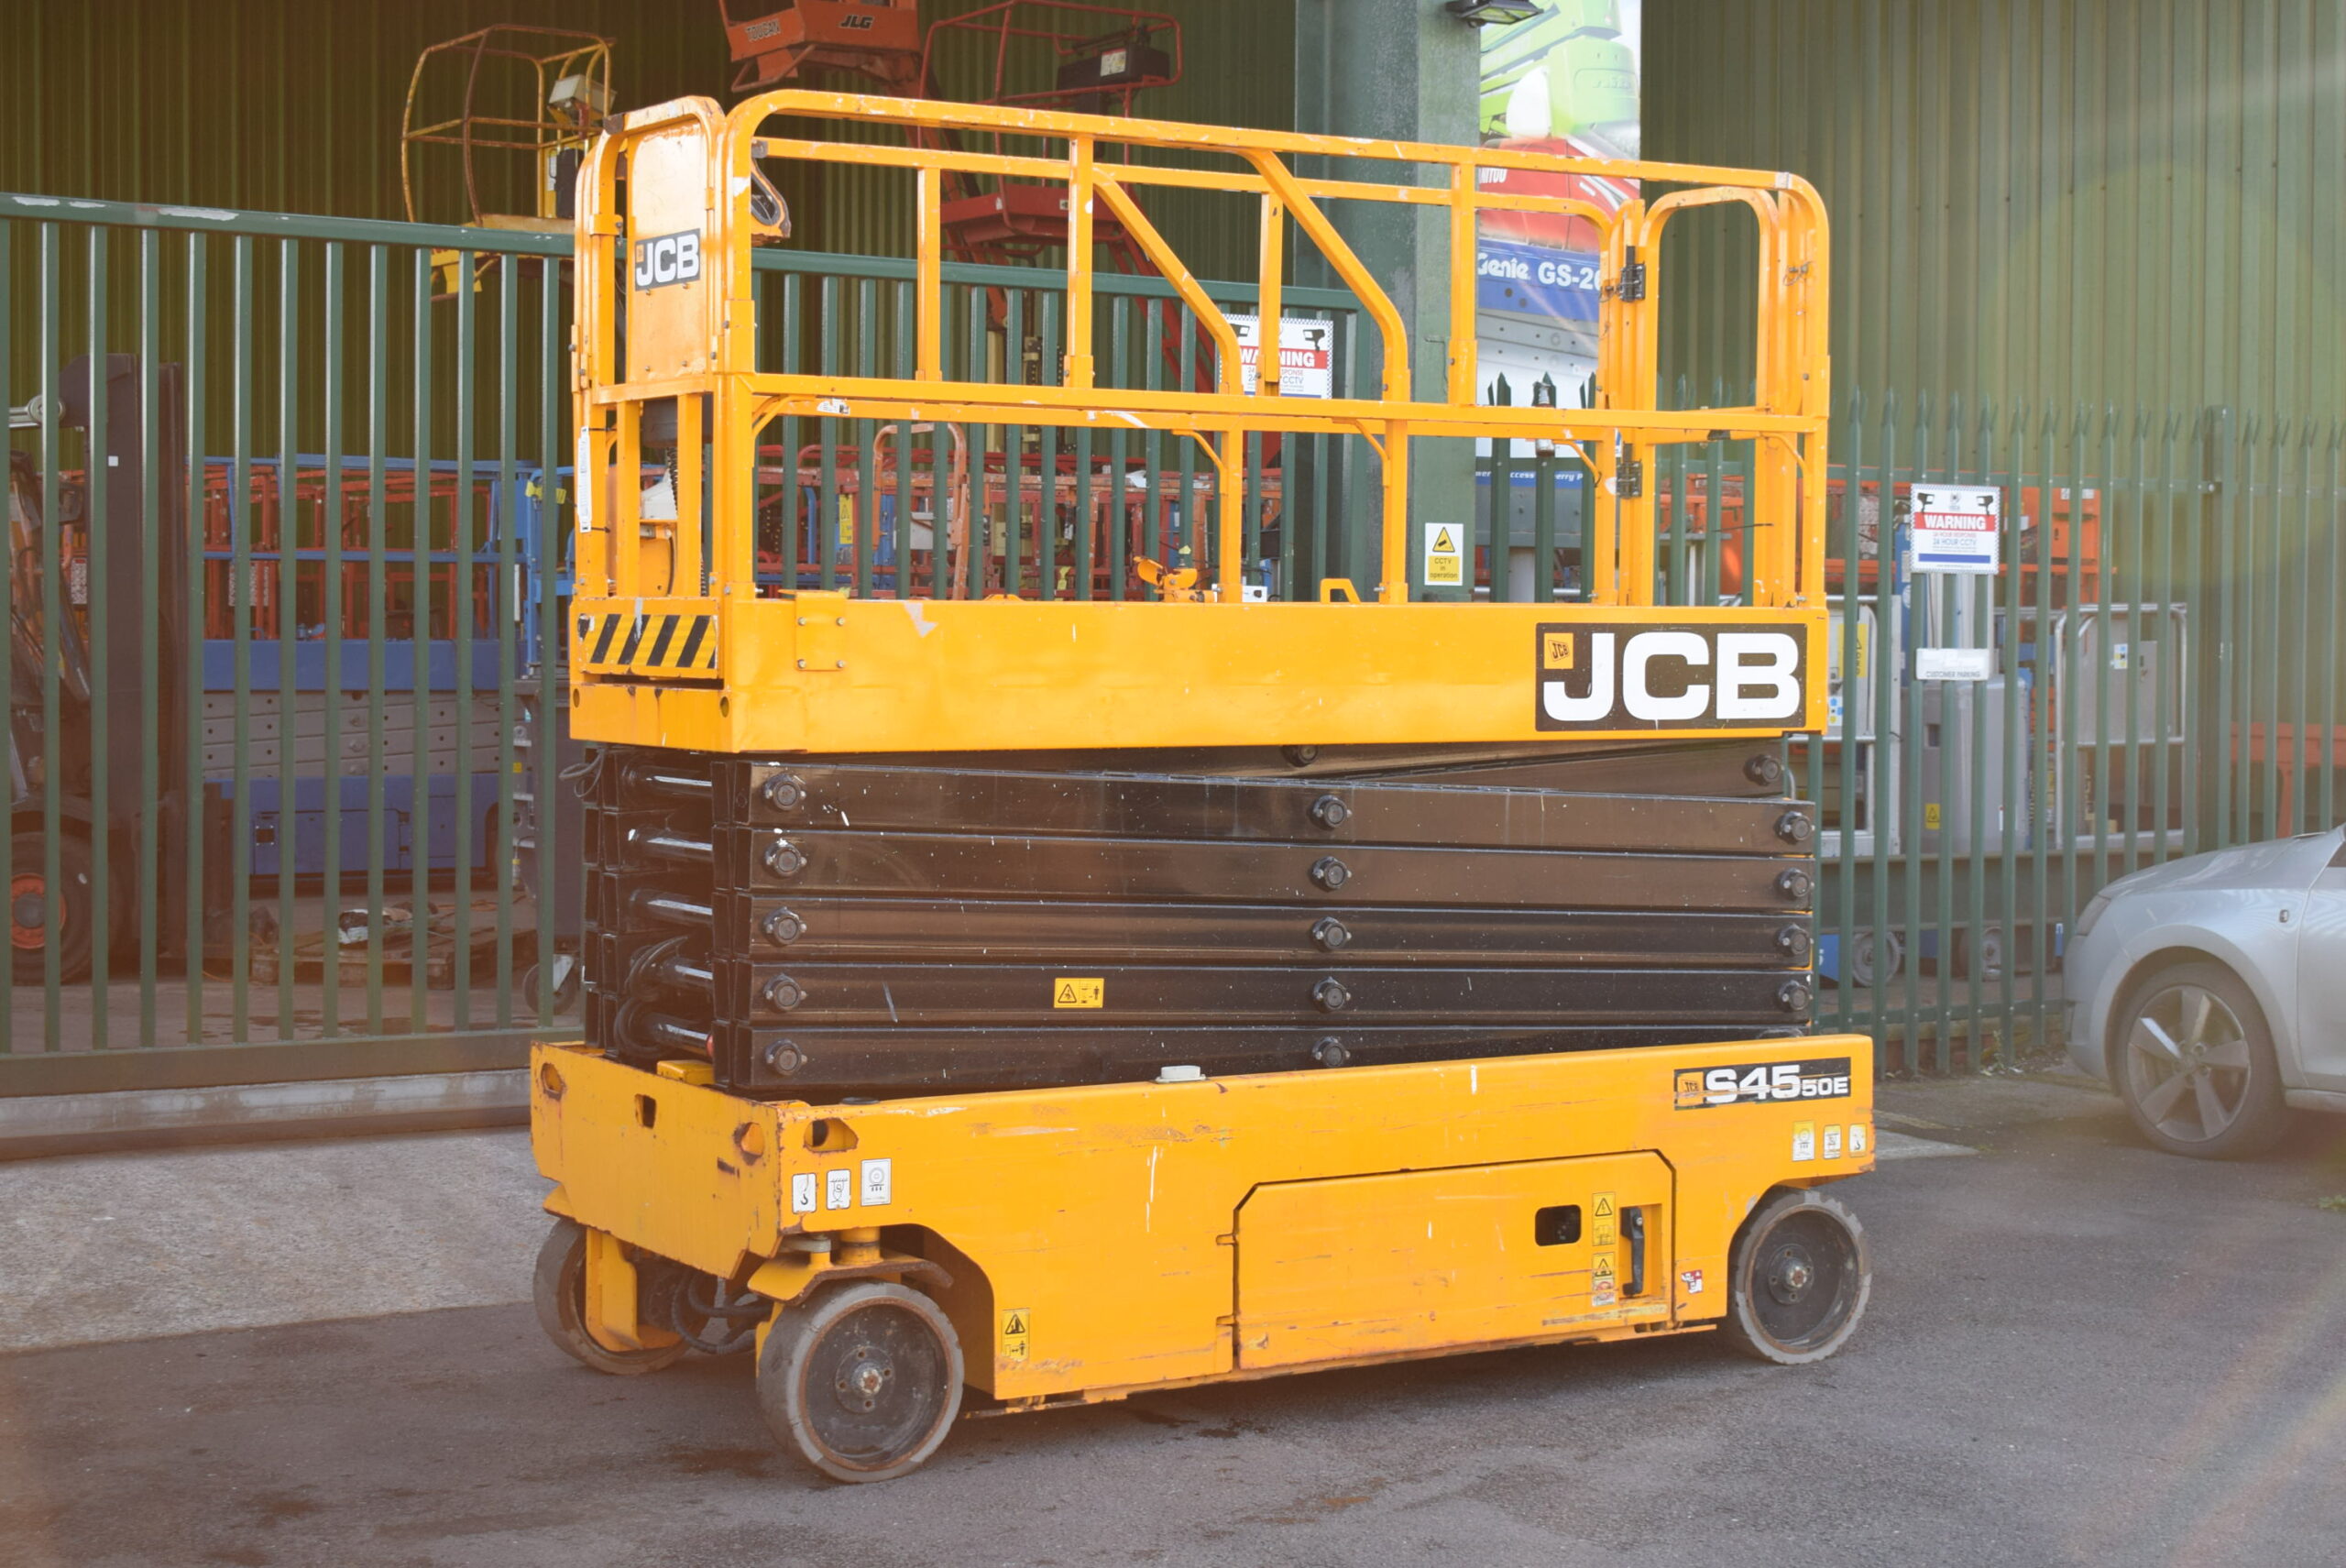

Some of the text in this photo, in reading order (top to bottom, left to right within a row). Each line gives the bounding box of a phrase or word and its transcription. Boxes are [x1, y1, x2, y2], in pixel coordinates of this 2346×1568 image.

[839, 15, 873, 29] JLG
[636, 234, 699, 286] JCB
[1924, 514, 1987, 530] WARNING
[1551, 642, 1569, 659] JCB
[1543, 632, 1800, 721] JCB
